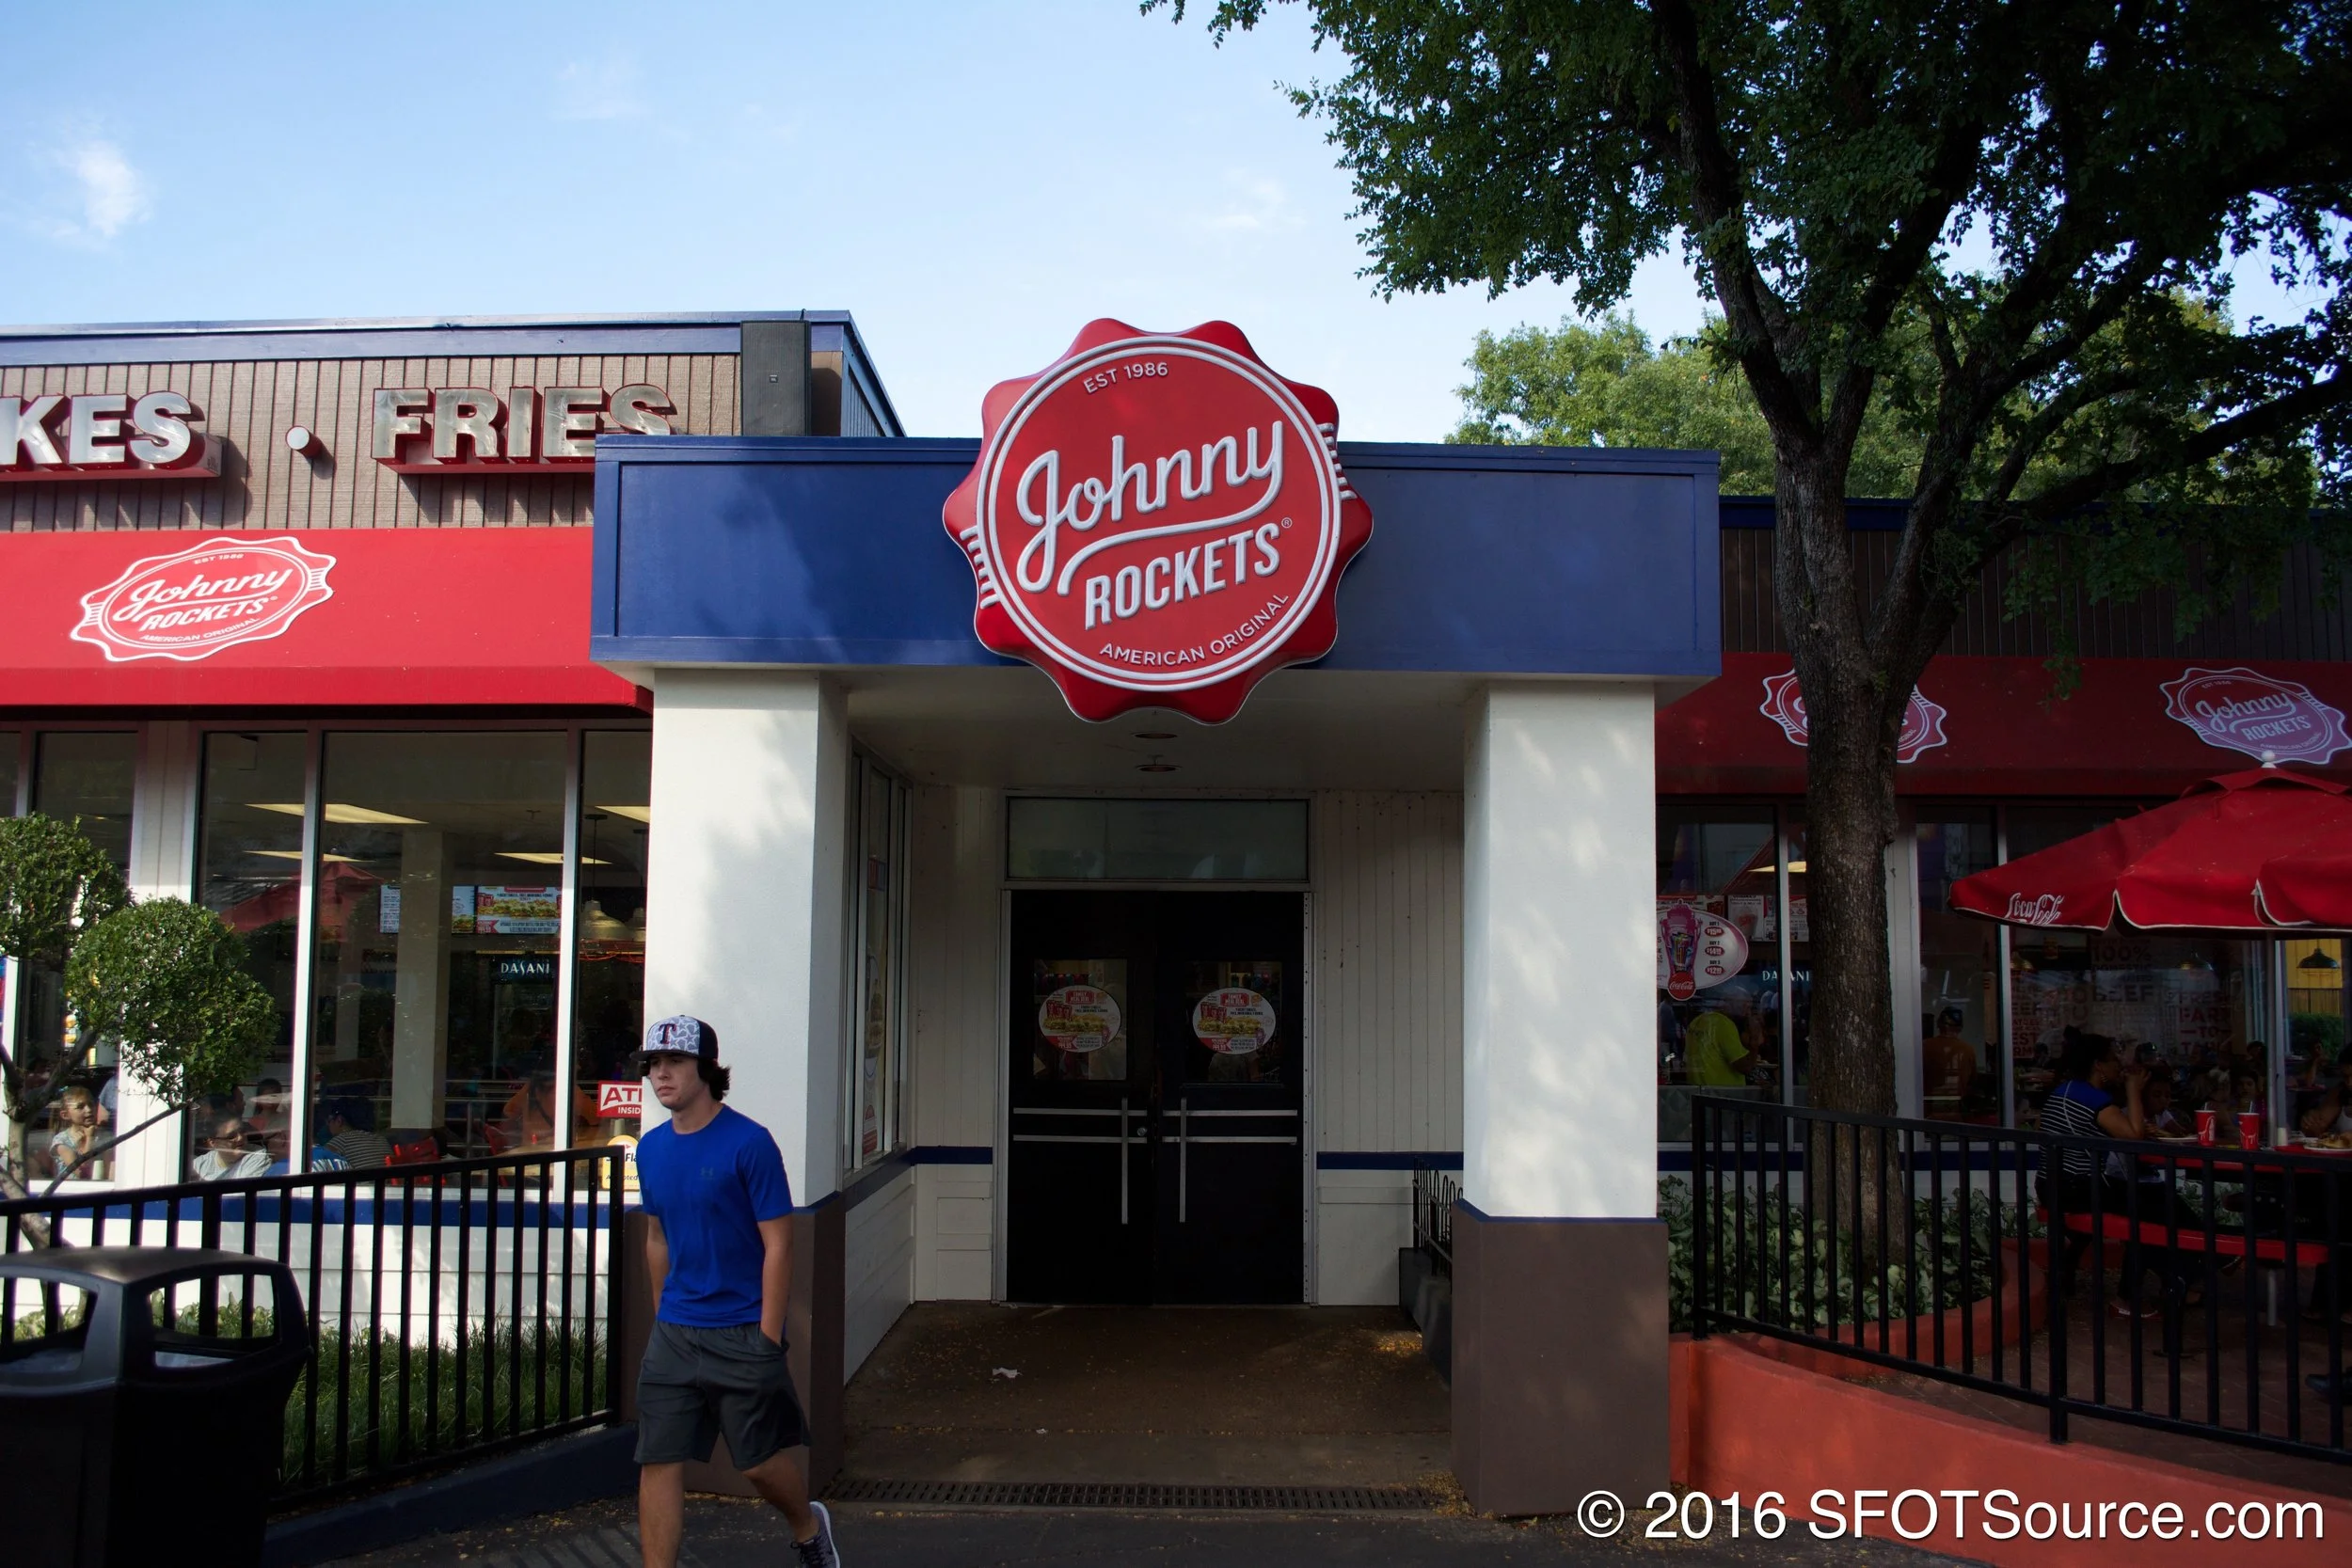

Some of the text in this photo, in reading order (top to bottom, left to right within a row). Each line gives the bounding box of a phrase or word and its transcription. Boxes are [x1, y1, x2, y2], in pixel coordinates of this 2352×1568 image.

[1083, 361, 1168, 394] EST 1986
[371, 384, 674, 461] FRIES
[1016, 420, 1283, 596] Johnny
[193, 556, 215, 564] EST
[112, 568, 294, 623] Johnny
[139, 617, 261, 642] AMERICAN ORIGINAL
[1099, 592, 1289, 666] AMERICAN ORIGINAL
[2195, 692, 2296, 733] Johnny
[501, 961, 550, 975] DASANI
[659, 1023, 676, 1045] T
